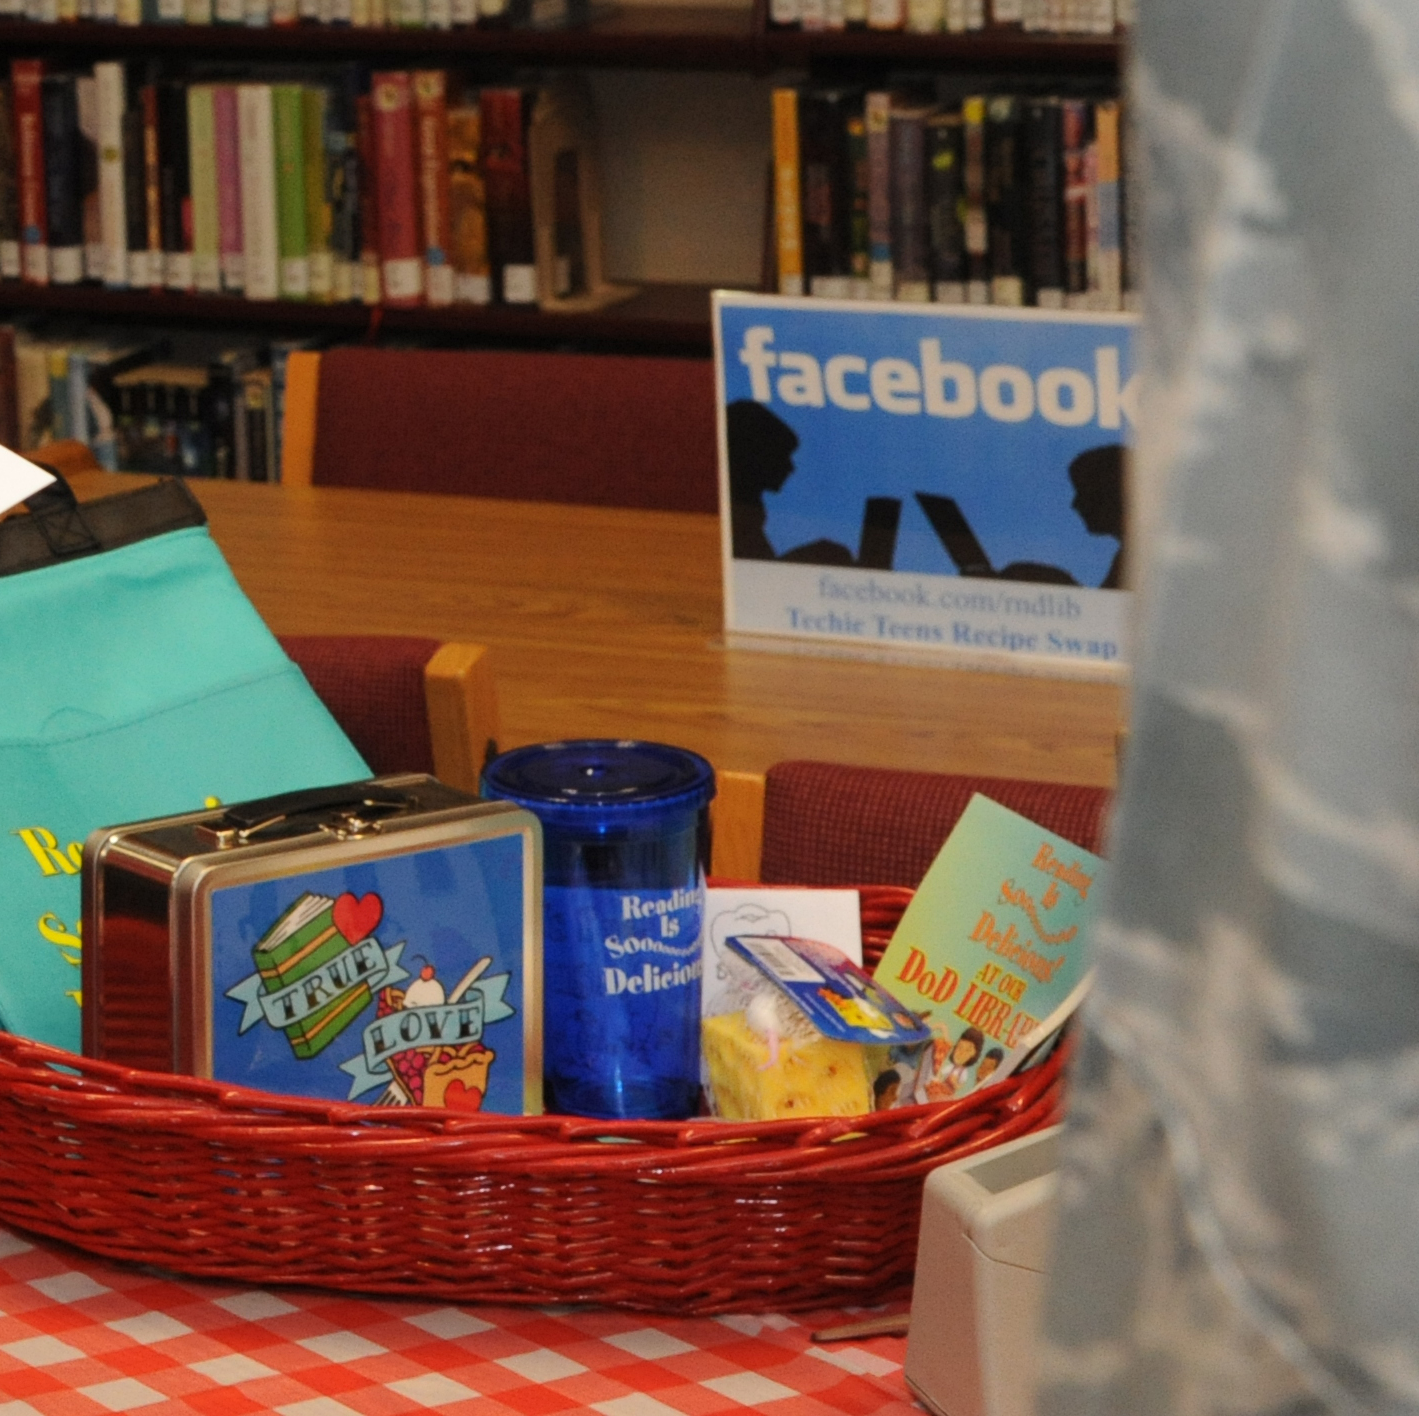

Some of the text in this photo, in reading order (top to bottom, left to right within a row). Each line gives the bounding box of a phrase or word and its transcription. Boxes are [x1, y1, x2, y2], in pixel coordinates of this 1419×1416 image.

[738, 325, 1142, 430] facebook
[874, 613, 943, 644] Teens
[953, 620, 1038, 654] Recipe
[1047, 628, 1118, 660] Swap
[271, 940, 379, 1022] TRUE
[895, 945, 960, 1004] DoD
[369, 1006, 482, 1056] LOVE
